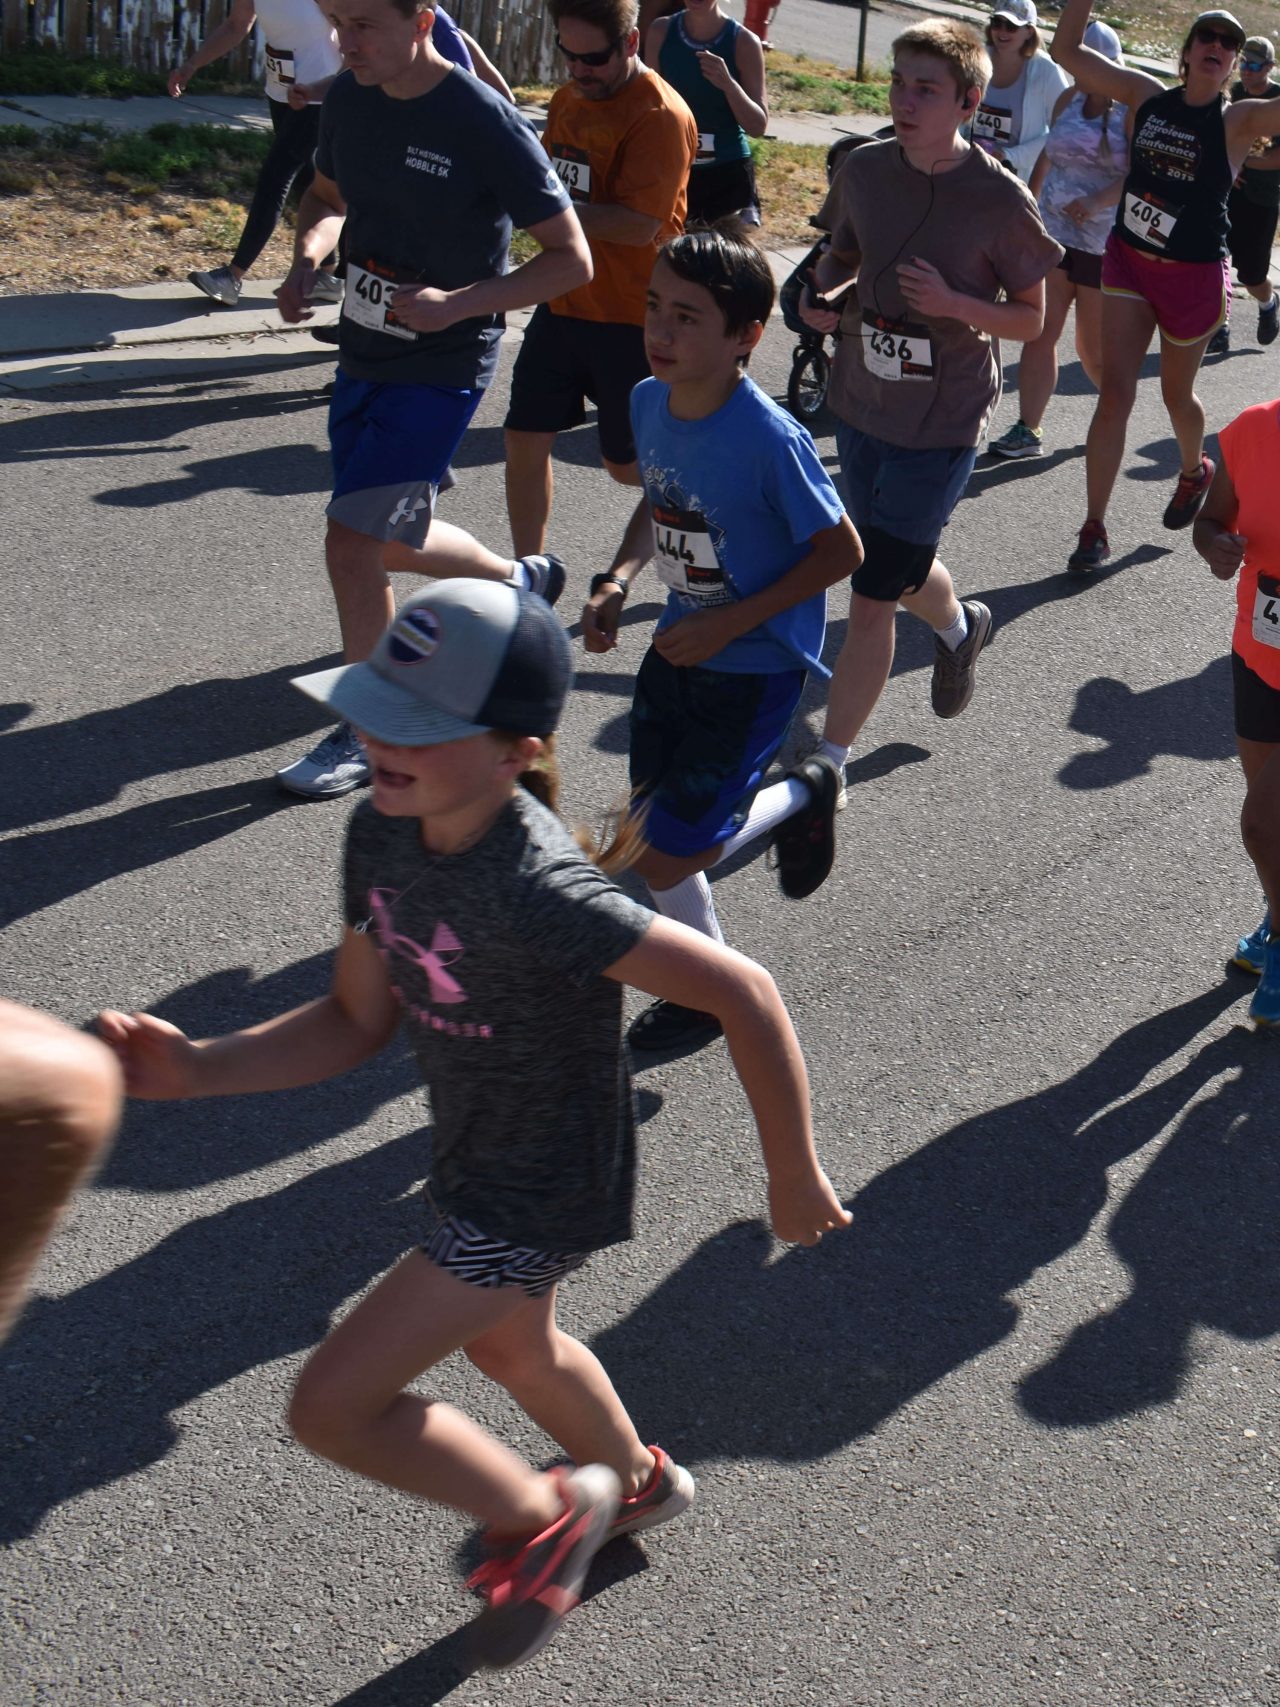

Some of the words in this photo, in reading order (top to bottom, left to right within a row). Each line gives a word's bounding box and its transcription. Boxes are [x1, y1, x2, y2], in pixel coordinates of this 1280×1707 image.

[976, 112, 1001, 129] 440
[1143, 121, 1196, 142] Petroleum
[1135, 136, 1196, 159] Conference
[405, 156, 437, 174] HOBBLE
[1131, 201, 1163, 228] 406
[870, 331, 913, 361] 436
[656, 526, 695, 564] 444
